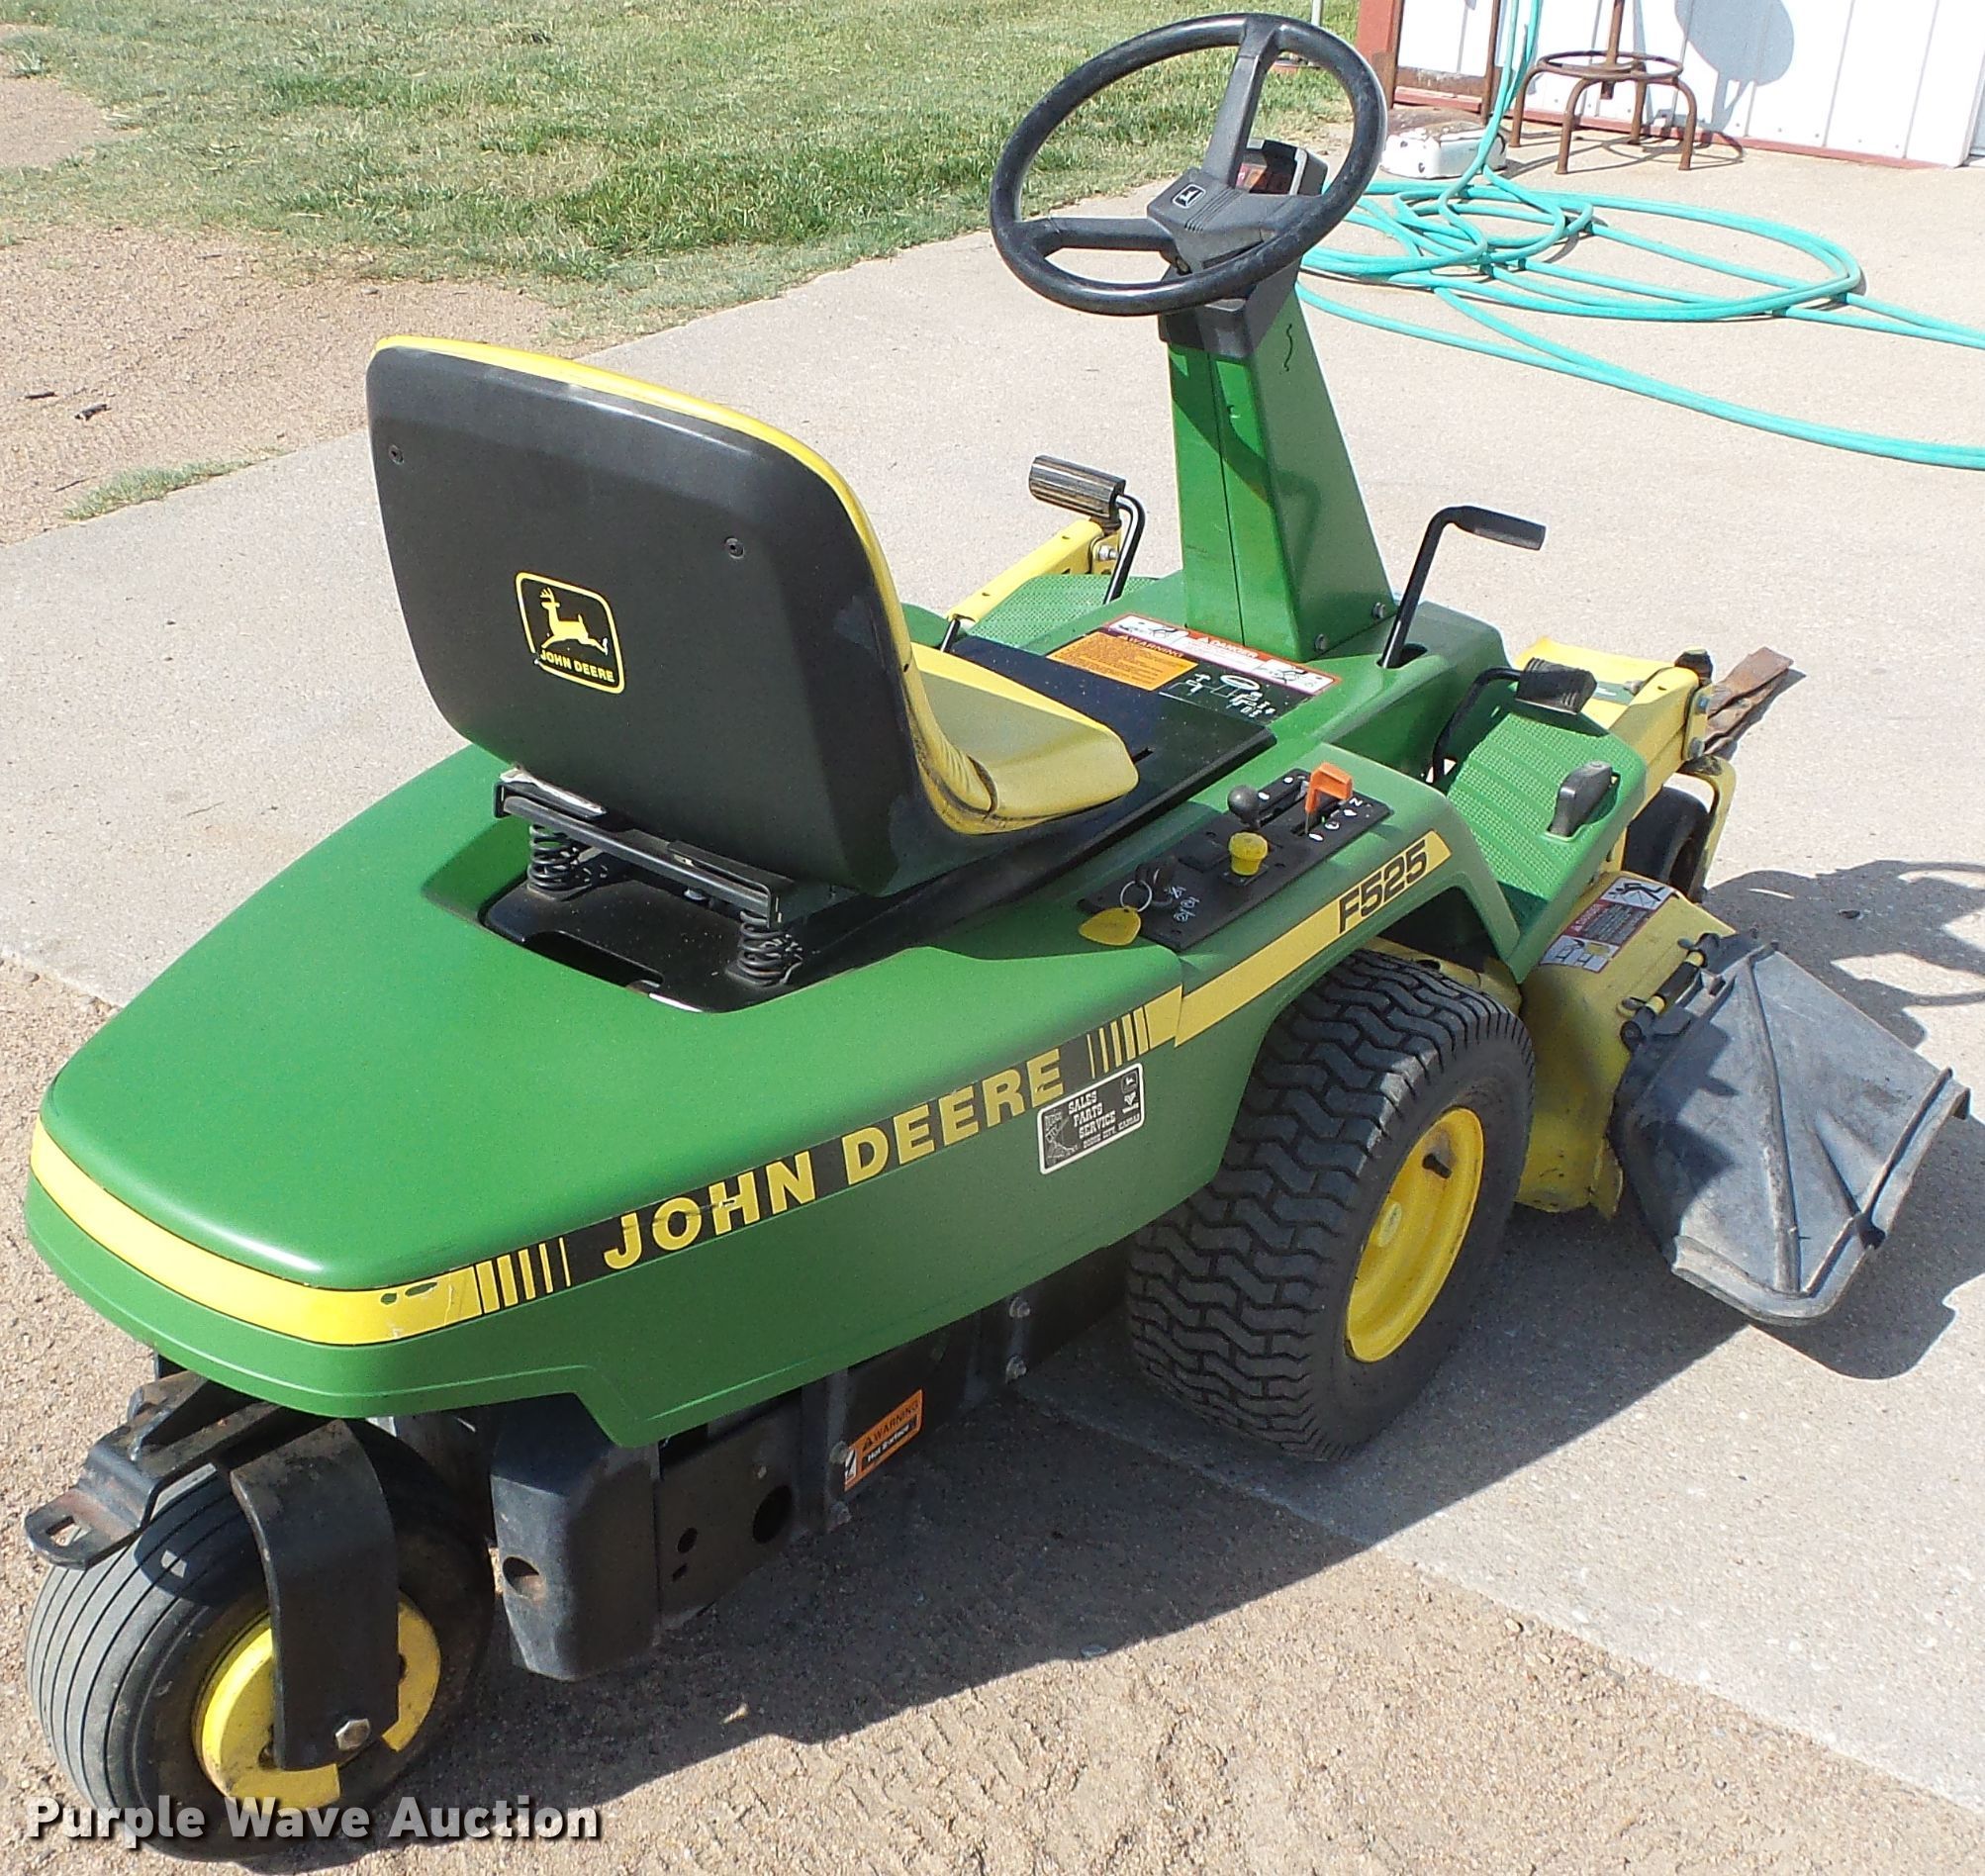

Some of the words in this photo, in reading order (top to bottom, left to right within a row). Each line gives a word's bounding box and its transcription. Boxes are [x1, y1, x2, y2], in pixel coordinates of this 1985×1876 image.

[540, 649, 572, 670] JOHN
[573, 660, 615, 683] DEERE
[1338, 839, 1428, 935] F525
[1068, 1089, 1097, 1116] SALES
[1073, 1101, 1103, 1128] PARTS
[1079, 1109, 1116, 1140] SERVICE
[603, 1151, 816, 1270] JOHN
[843, 1048, 1065, 1185] DEERE
